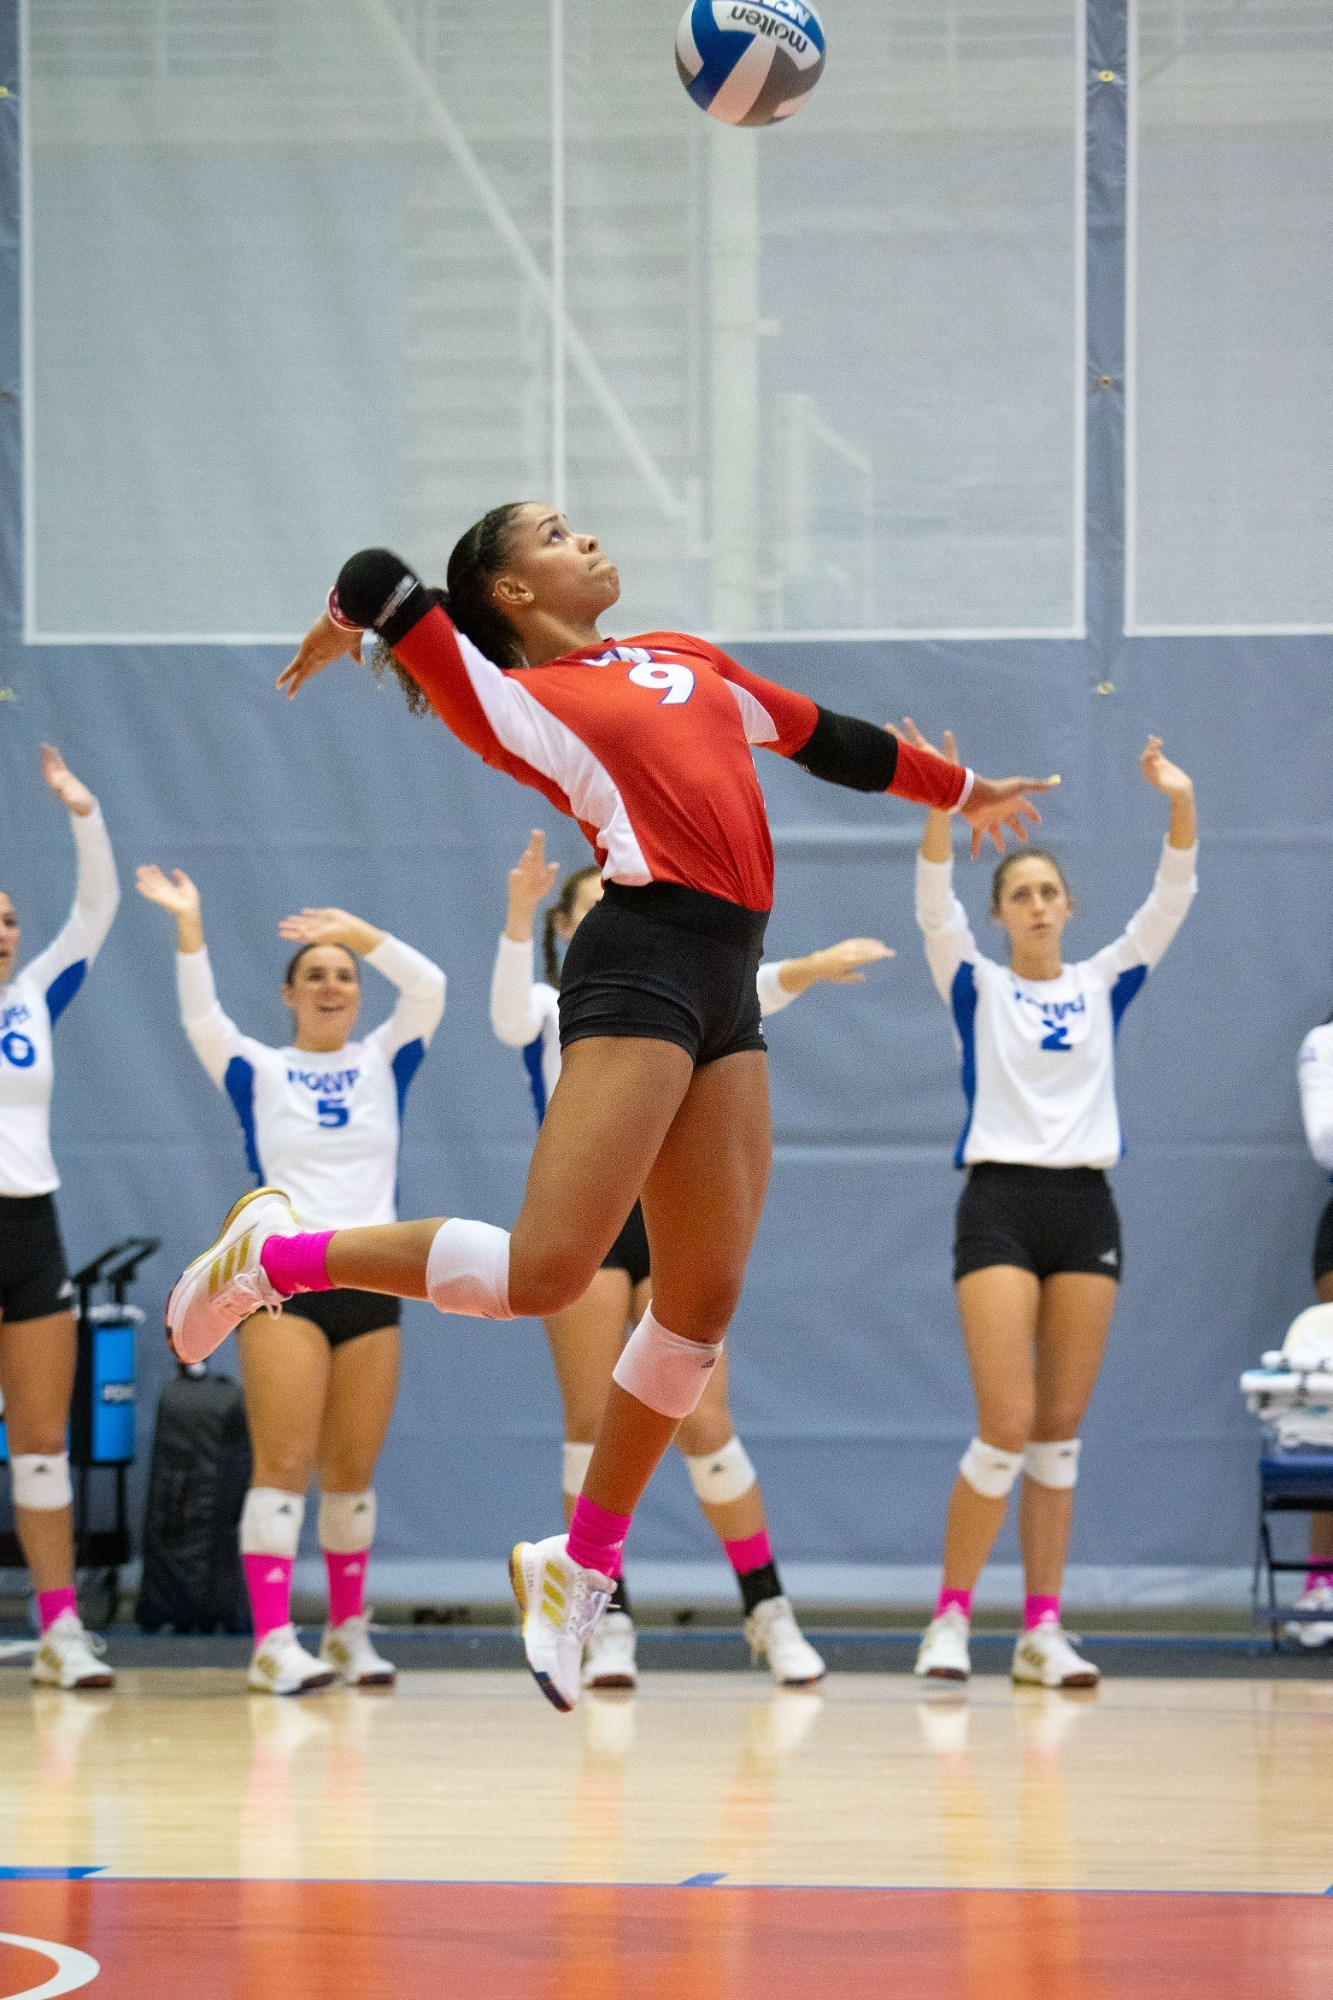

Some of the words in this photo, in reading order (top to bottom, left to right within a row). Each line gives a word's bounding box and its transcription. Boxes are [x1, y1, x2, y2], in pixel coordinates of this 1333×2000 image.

[731, 5, 808, 53] molten
[628, 662, 695, 705] 9
[1041, 1020, 1072, 1050] 2
[317, 1098, 350, 1128] 5
